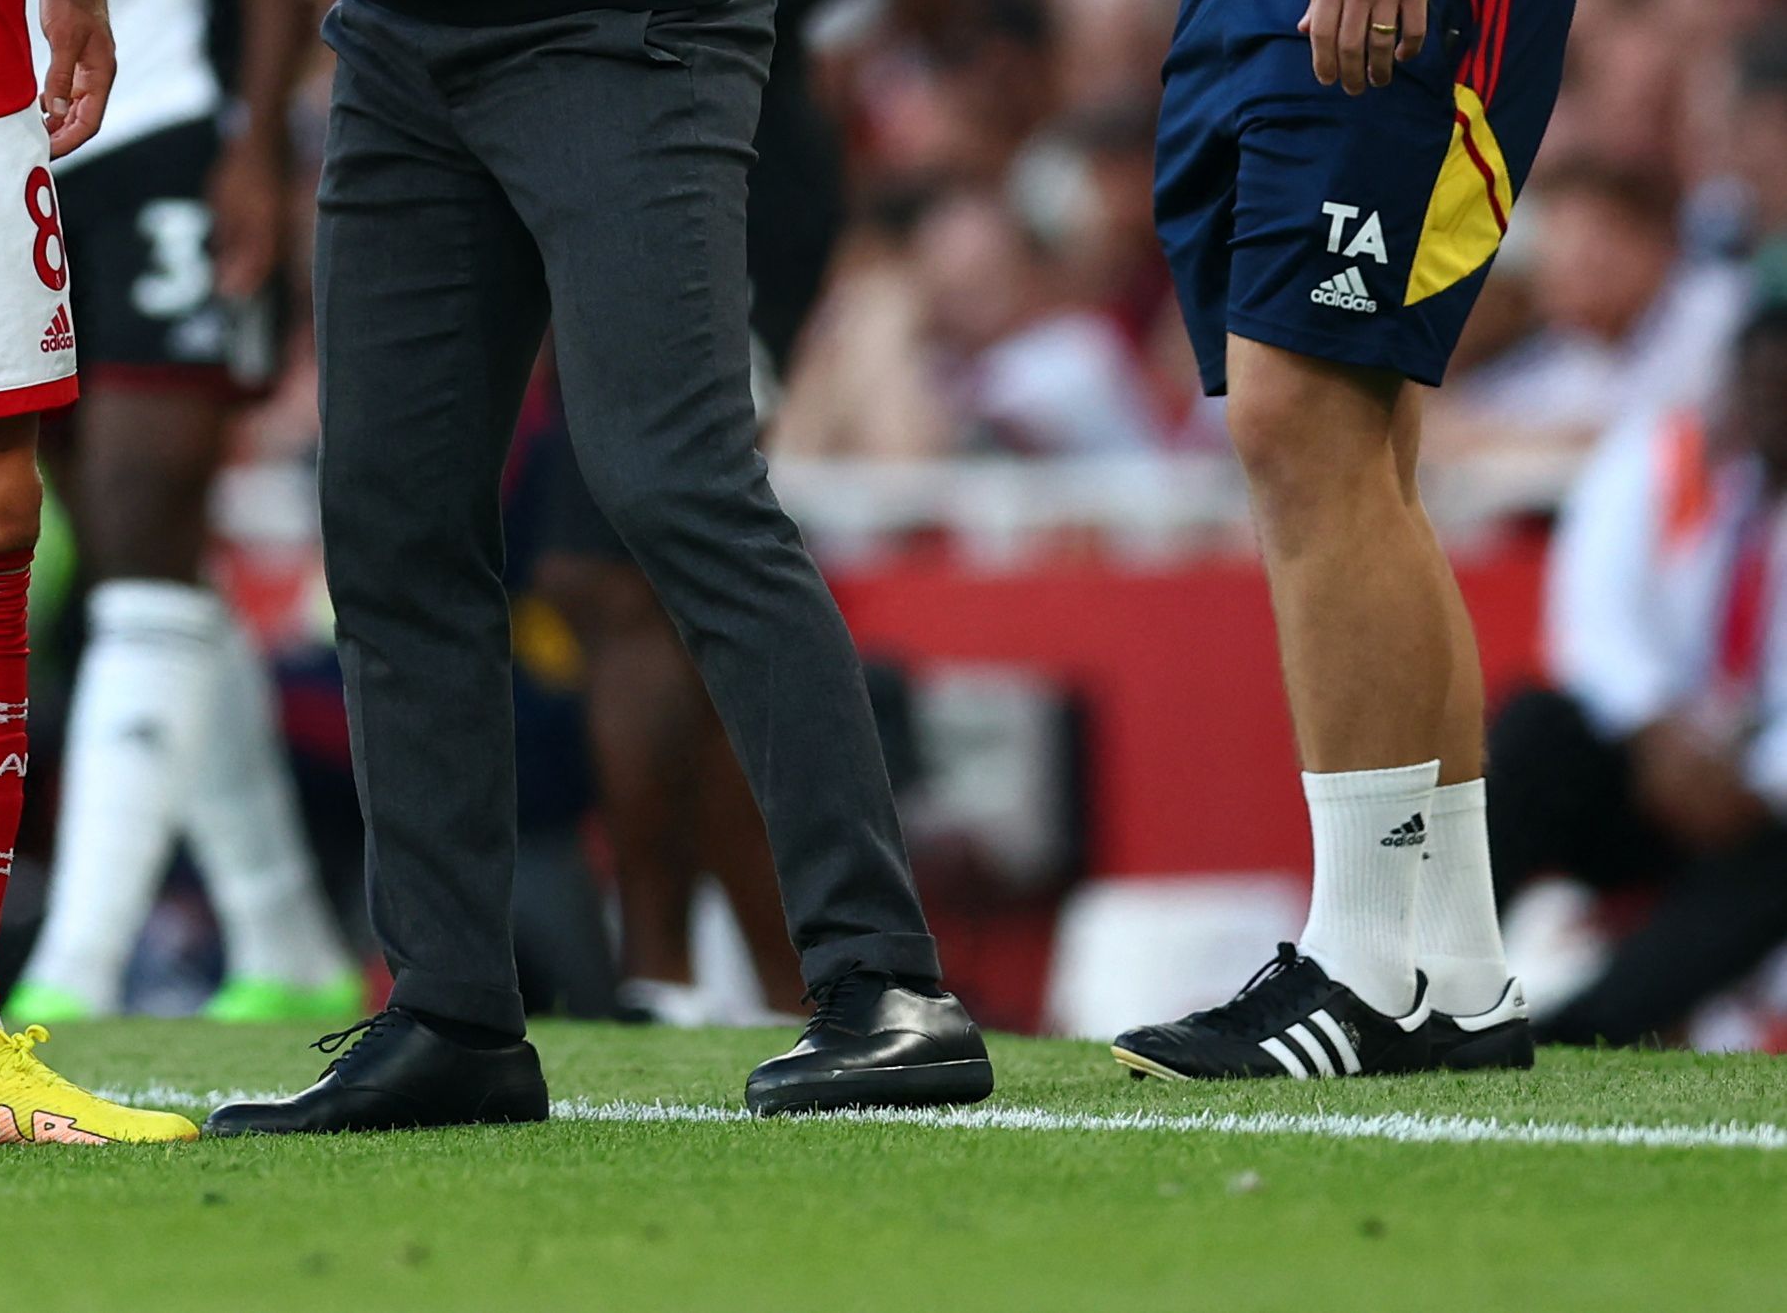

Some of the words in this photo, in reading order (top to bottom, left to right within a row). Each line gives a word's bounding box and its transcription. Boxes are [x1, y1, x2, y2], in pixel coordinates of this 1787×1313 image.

[25, 166, 67, 292] 8
[1321, 201, 1388, 264] TA
[1310, 288, 1377, 313] adidas
